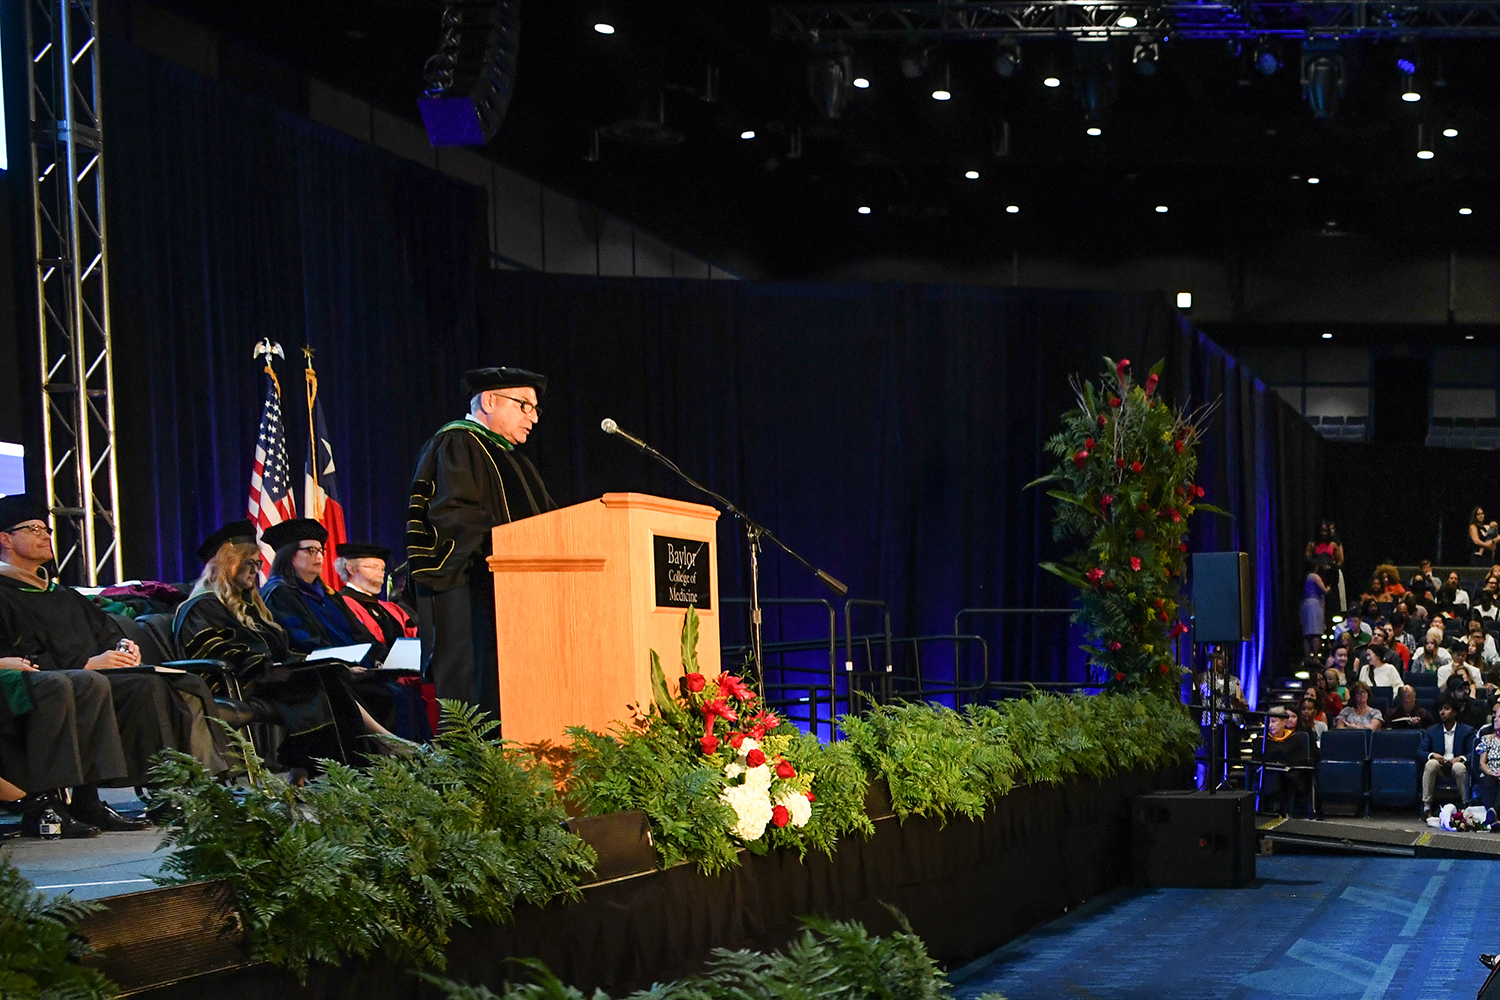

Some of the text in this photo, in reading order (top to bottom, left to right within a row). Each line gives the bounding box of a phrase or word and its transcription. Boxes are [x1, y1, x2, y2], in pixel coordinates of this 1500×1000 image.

[667, 543, 697, 569] Baylor
[668, 569, 697, 587] College of
[668, 586, 698, 603] Medicine
